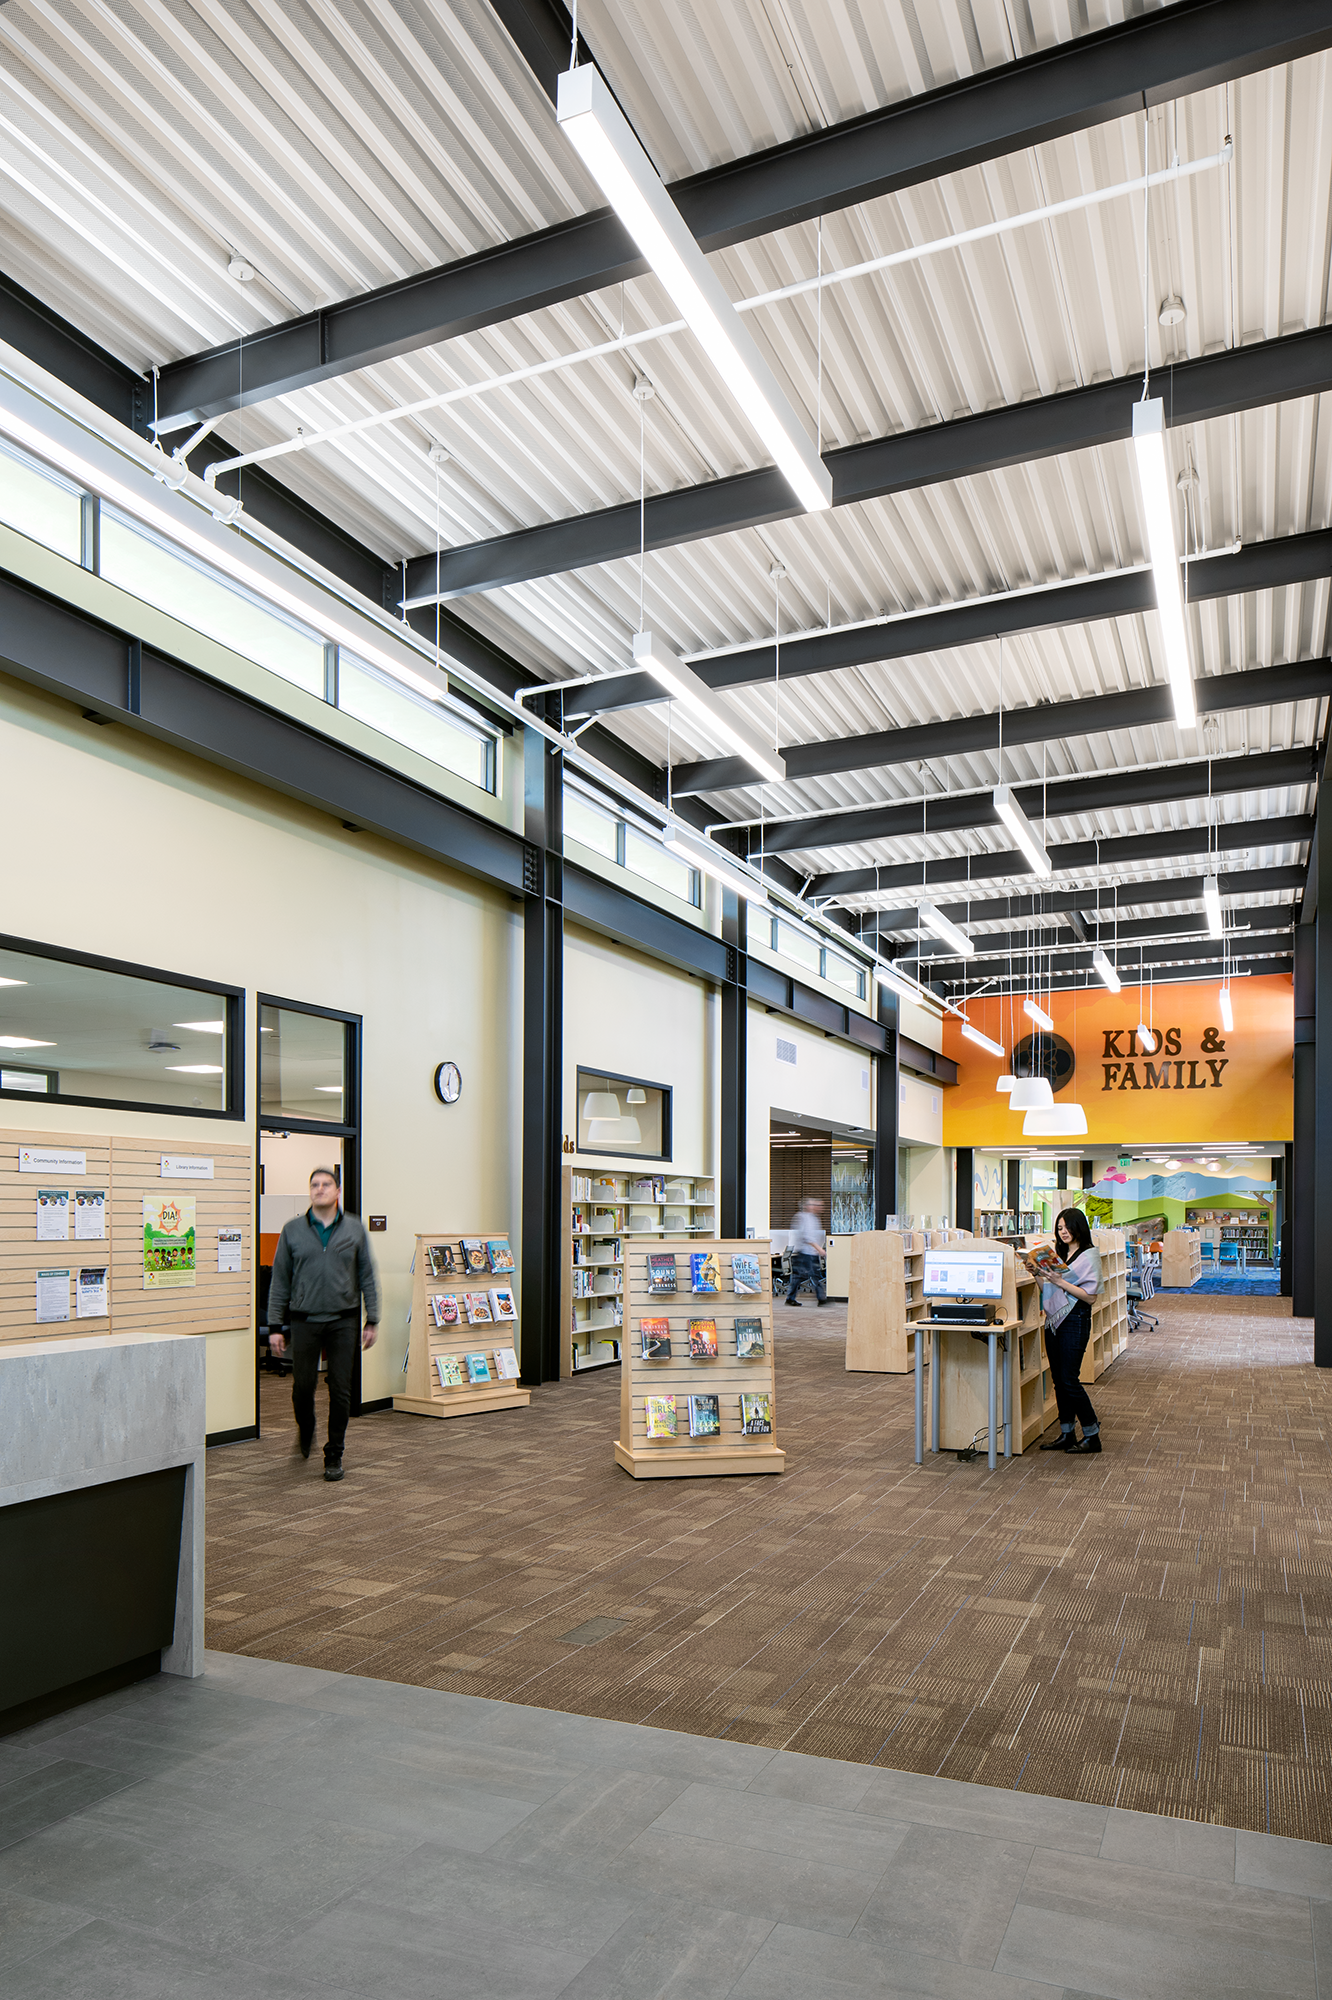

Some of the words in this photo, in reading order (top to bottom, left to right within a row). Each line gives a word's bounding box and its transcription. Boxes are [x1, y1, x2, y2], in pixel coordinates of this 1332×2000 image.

[1102, 1027, 1182, 1058] KIDS
[1200, 1027, 1226, 1053] &
[1102, 1059, 1229, 1091] FAMILY
[162, 1211, 178, 1221] DIA!
[652, 1405, 673, 1414] GIRLS
